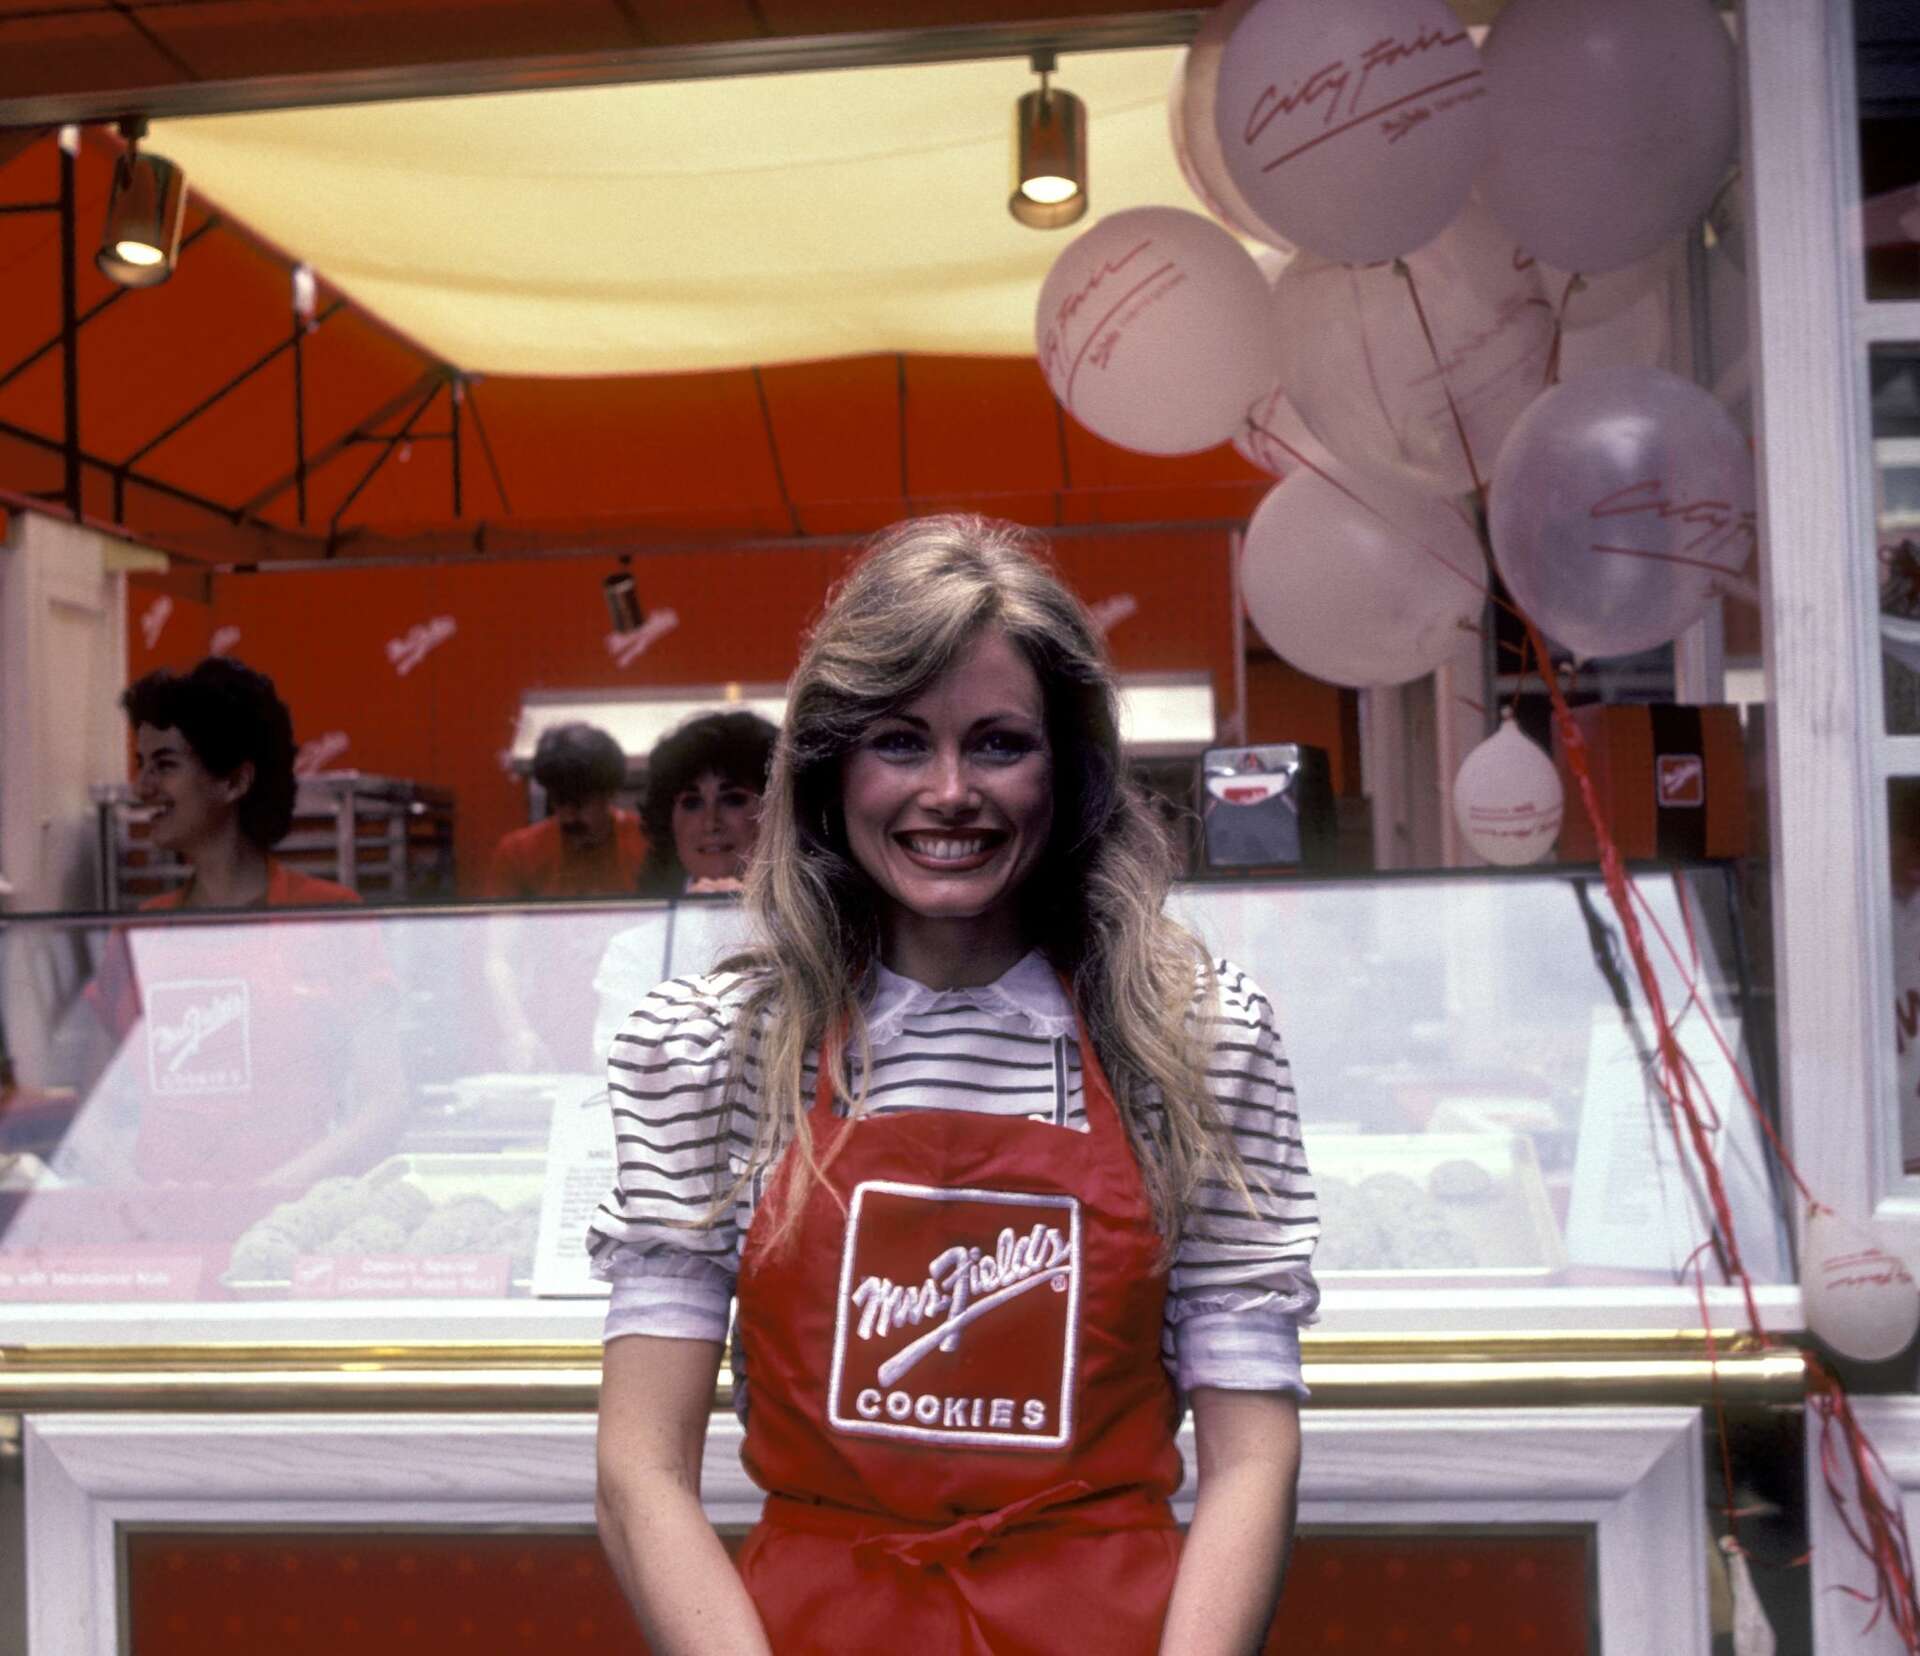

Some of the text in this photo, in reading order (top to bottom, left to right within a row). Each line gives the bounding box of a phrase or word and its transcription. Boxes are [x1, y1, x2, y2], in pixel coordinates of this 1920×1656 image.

[1245, 60, 1351, 145] City
[1350, 28, 1470, 116] Fair
[1589, 479, 1732, 551] City
[928, 1223, 1073, 1351] Fields
[855, 1387, 1046, 1429] COOKIES
